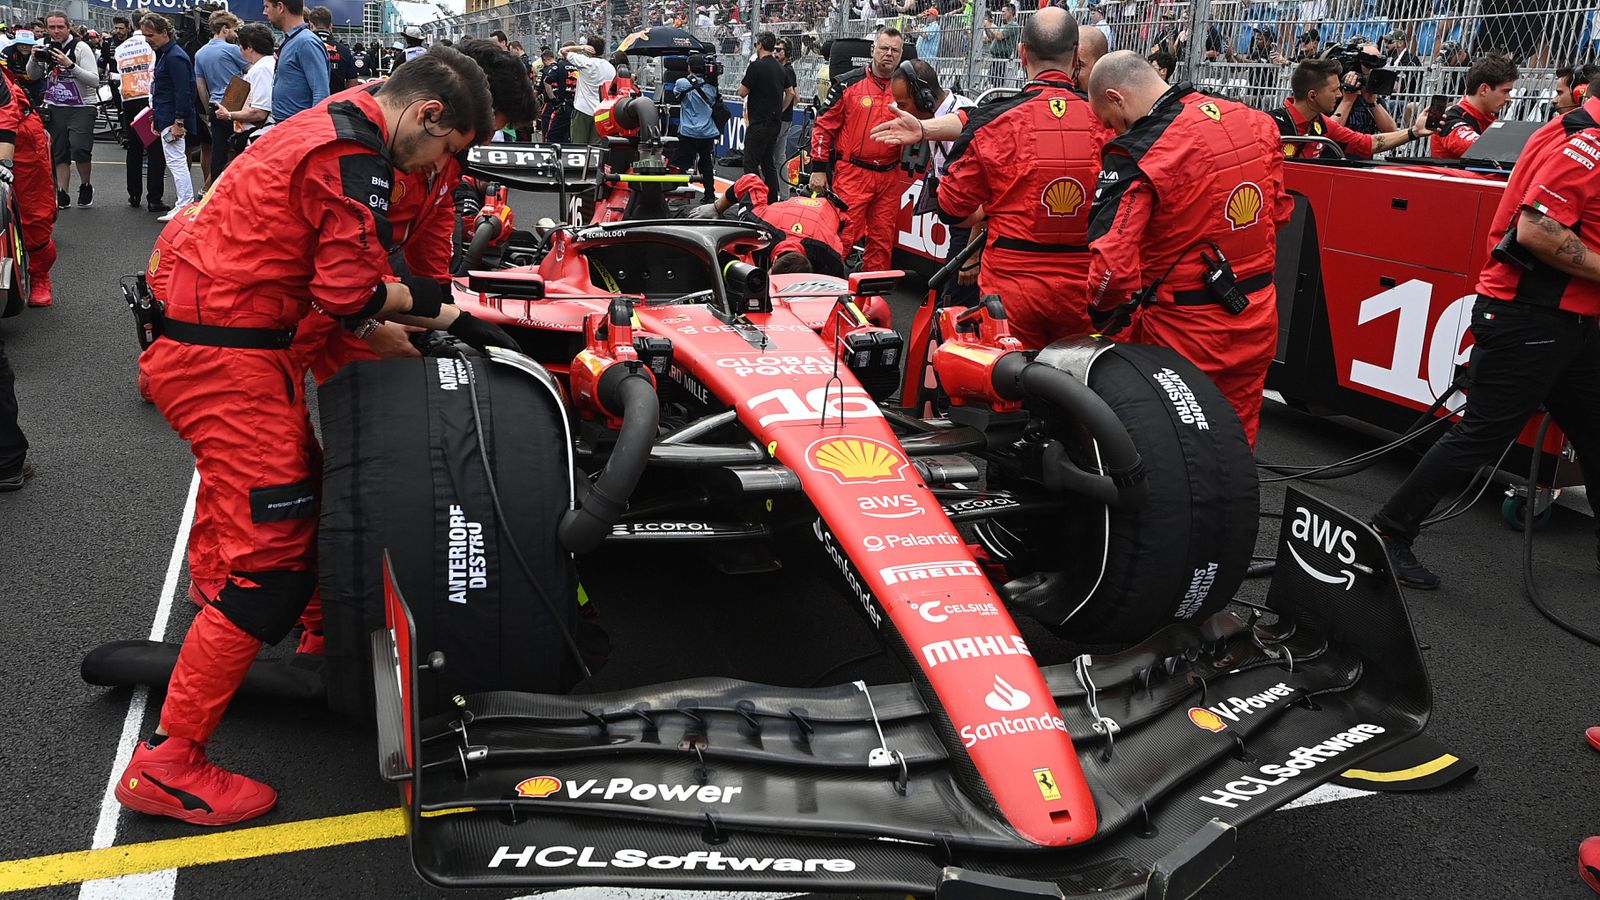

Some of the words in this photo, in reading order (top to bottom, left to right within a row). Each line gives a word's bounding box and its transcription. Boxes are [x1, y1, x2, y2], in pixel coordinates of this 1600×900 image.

[569, 195, 583, 229] 16
[586, 229, 627, 239] TECHNOLOGY
[517, 319, 564, 329] HARMAN
[716, 356, 842, 368] GLOBAL
[735, 366, 842, 377] POKER
[684, 374, 708, 404] MILLE
[1153, 372, 1195, 425] SINISTRO
[1161, 367, 1209, 431] ANTERIORE
[747, 386, 884, 428] 16
[857, 494, 918, 510] aws
[950, 498, 1017, 511] ECOPOL
[634, 523, 713, 531] ECOPOL
[1291, 507, 1357, 565] aws
[887, 534, 958, 548] Palantir
[824, 531, 882, 630] Santander
[879, 560, 982, 586] PIRELLI
[944, 603, 997, 613] CELSIUS
[922, 635, 1032, 668] MAHLE
[1209, 682, 1295, 722] V-Power
[1199, 722, 1386, 808] HCLSoftware
[565, 777, 742, 803] V-Power
[487, 846, 856, 872] HCLSoftware
